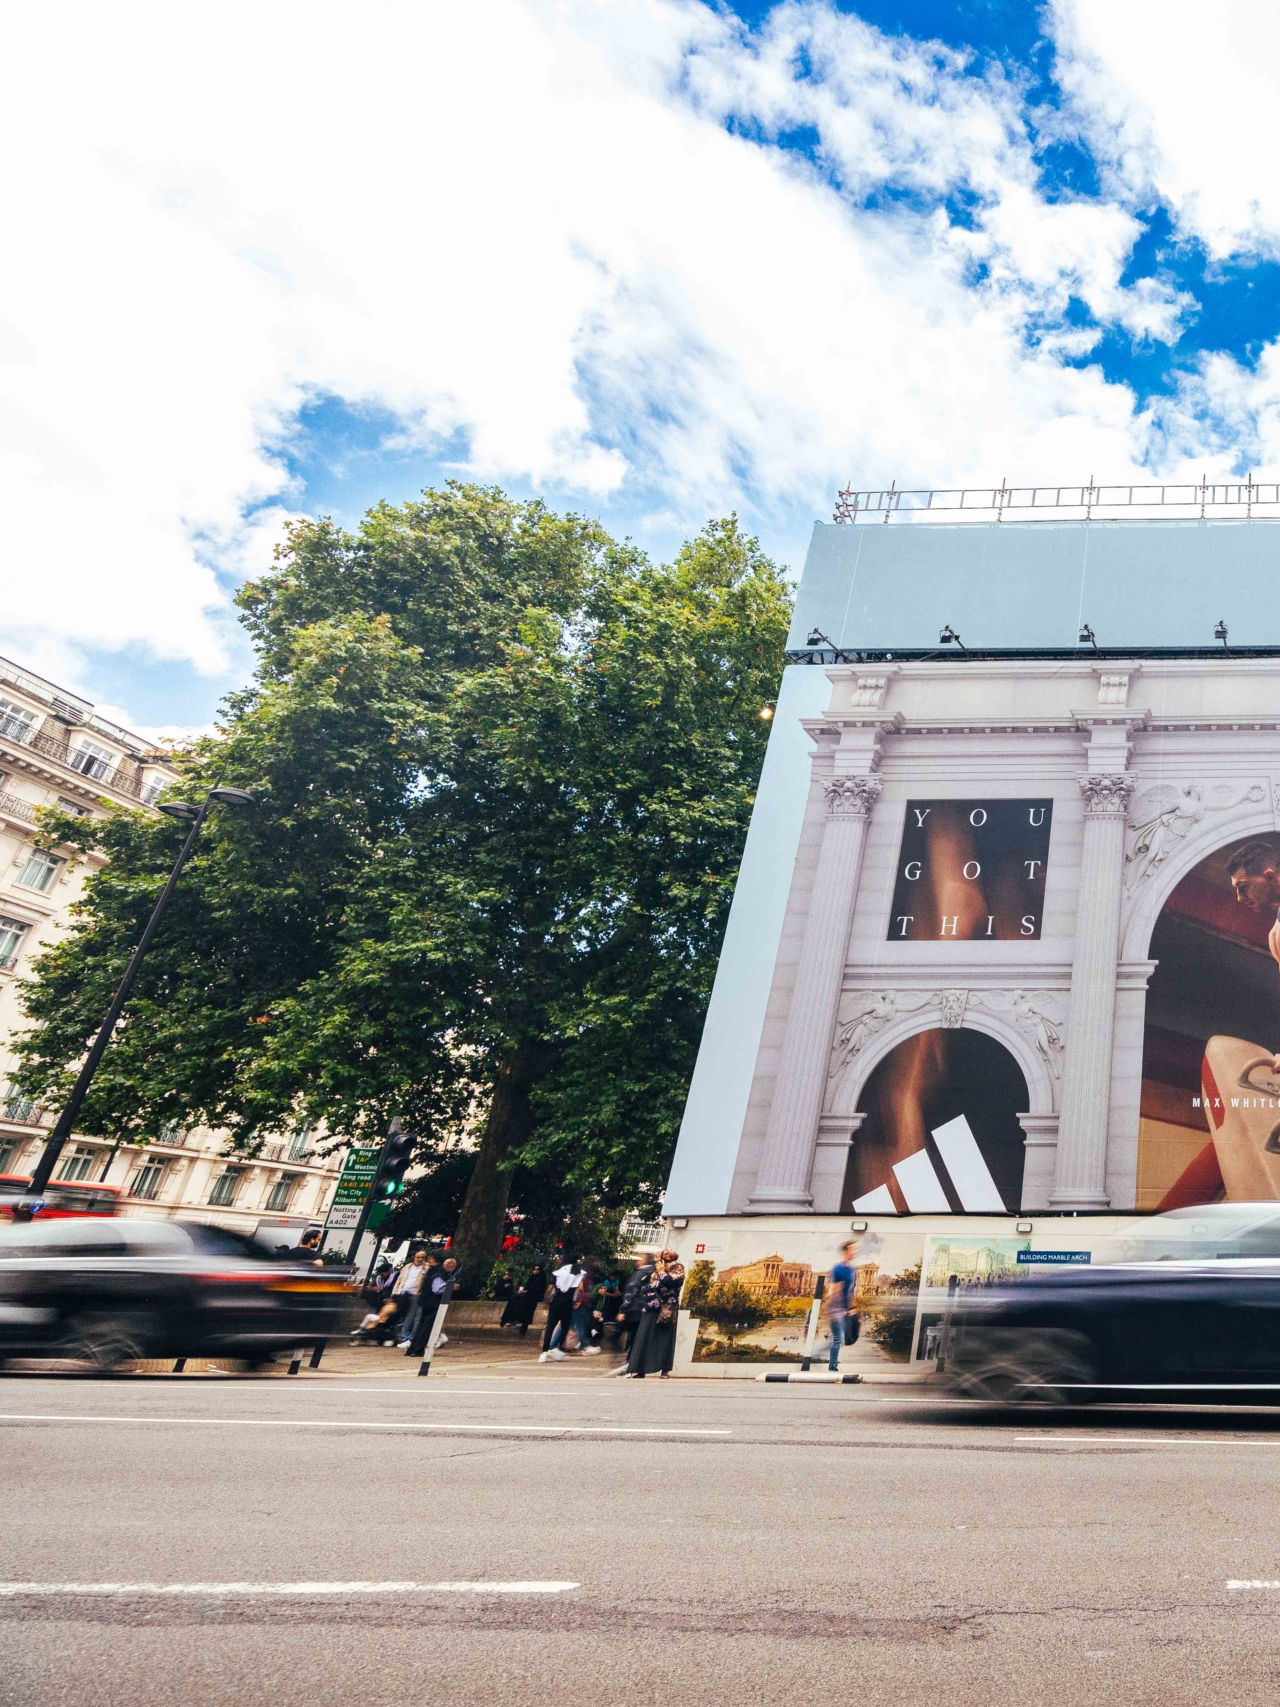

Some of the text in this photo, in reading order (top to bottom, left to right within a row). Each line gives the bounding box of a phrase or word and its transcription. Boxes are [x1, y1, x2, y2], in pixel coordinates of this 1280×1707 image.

[913, 808, 1046, 828] YOU
[903, 860, 1042, 882] GOT
[896, 915, 1036, 937] THIS
[1192, 1097, 1221, 1109] MAX
